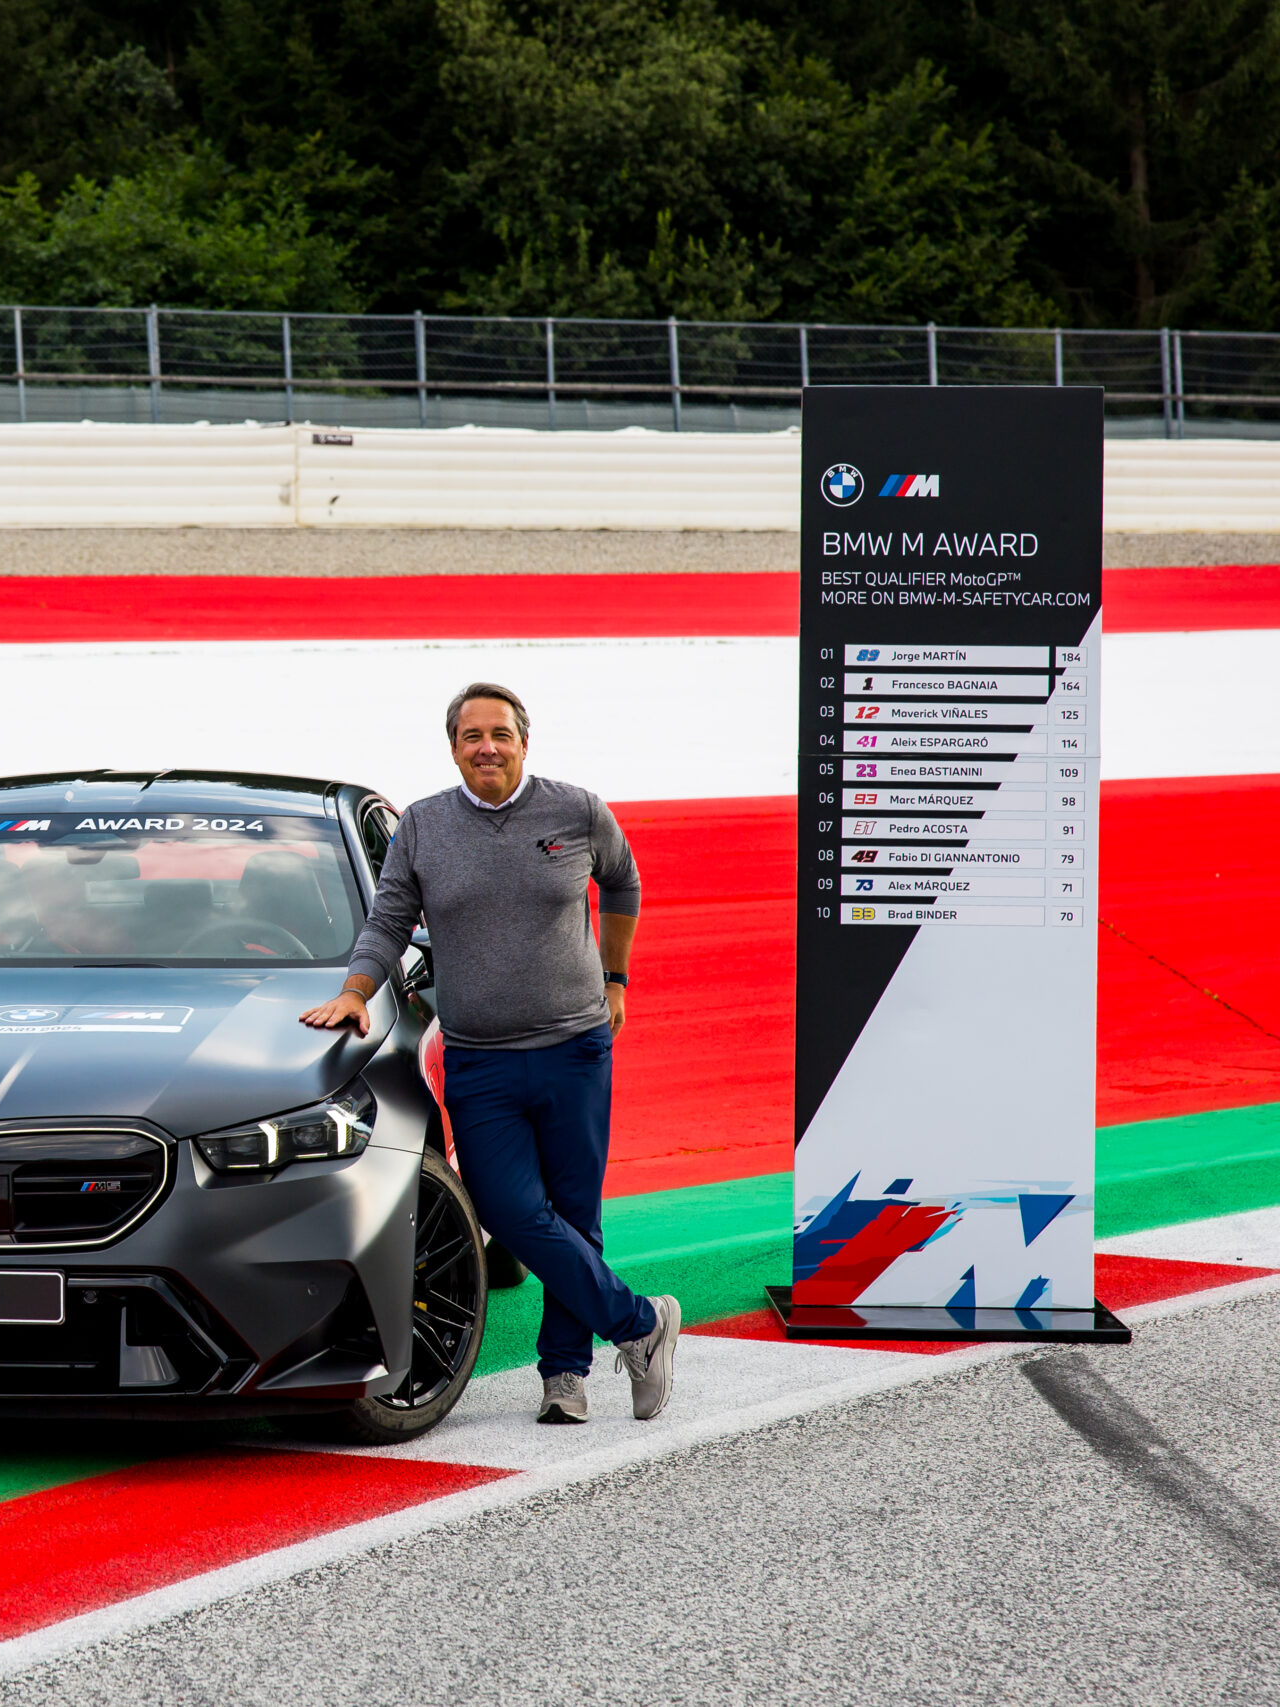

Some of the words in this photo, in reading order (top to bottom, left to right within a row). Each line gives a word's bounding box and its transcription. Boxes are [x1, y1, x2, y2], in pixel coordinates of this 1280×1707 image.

[822, 532, 893, 556] BMW
[902, 532, 924, 556] M
[932, 533, 1039, 557] AWARD
[821, 571, 862, 585] BEST
[865, 572, 946, 587] QUALIFIER
[821, 591, 867, 605] MORE
[871, 591, 894, 605] ON
[899, 592, 1091, 606] BMW-M-SAFETYCAR.COM
[820, 648, 834, 660] 01
[856, 649, 880, 662] 89
[891, 651, 920, 662] Jorge
[922, 649, 967, 661] MARTÍN
[1062, 652, 1081, 662] 184
[820, 677, 835, 689] 02
[862, 677, 873, 691] 1
[892, 680, 945, 690] Francesco
[947, 680, 998, 690] BAGNAIA
[1061, 681, 1080, 691] 164
[820, 706, 835, 718] 03
[855, 706, 880, 719] 12
[891, 708, 938, 719] Maverick
[940, 707, 988, 719] VIÑALES
[1061, 710, 1079, 720] 125
[820, 735, 835, 746] 04
[856, 735, 878, 748] 41
[891, 737, 917, 747] Aleix
[920, 736, 989, 748] ESPARGARÓ
[1061, 739, 1078, 749] 114
[819, 763, 834, 775] 05
[856, 764, 877, 777] 23
[890, 767, 917, 776] Enea
[919, 767, 983, 777] BASTIANINI
[1060, 768, 1078, 778] 109
[819, 792, 834, 804] 06
[854, 793, 878, 805] 93
[890, 795, 915, 805] Marc
[918, 793, 974, 806] MÁRQUEZ
[1061, 797, 1076, 807] 98
[75, 818, 185, 831] AWARD
[192, 818, 264, 832] 2024
[818, 821, 833, 833] 07
[889, 824, 920, 834] Pedro
[922, 824, 968, 834] ACOSTA
[1062, 826, 1074, 835] 91
[818, 850, 834, 862] 08
[851, 850, 878, 863] 49
[889, 852, 918, 863] Fabio
[920, 853, 932, 863] DI
[934, 853, 1020, 863] GIANNANTONIO
[1061, 854, 1074, 864] 79
[817, 879, 833, 890] 09
[855, 879, 873, 891] 73
[888, 881, 912, 891] Alex
[914, 880, 970, 893] MÁRQUEZ
[1062, 883, 1073, 893] 71
[816, 907, 831, 919] 10
[851, 907, 875, 920] 33
[888, 910, 913, 920] Brad
[915, 910, 957, 920] BINDER
[1060, 912, 1073, 922] 70
